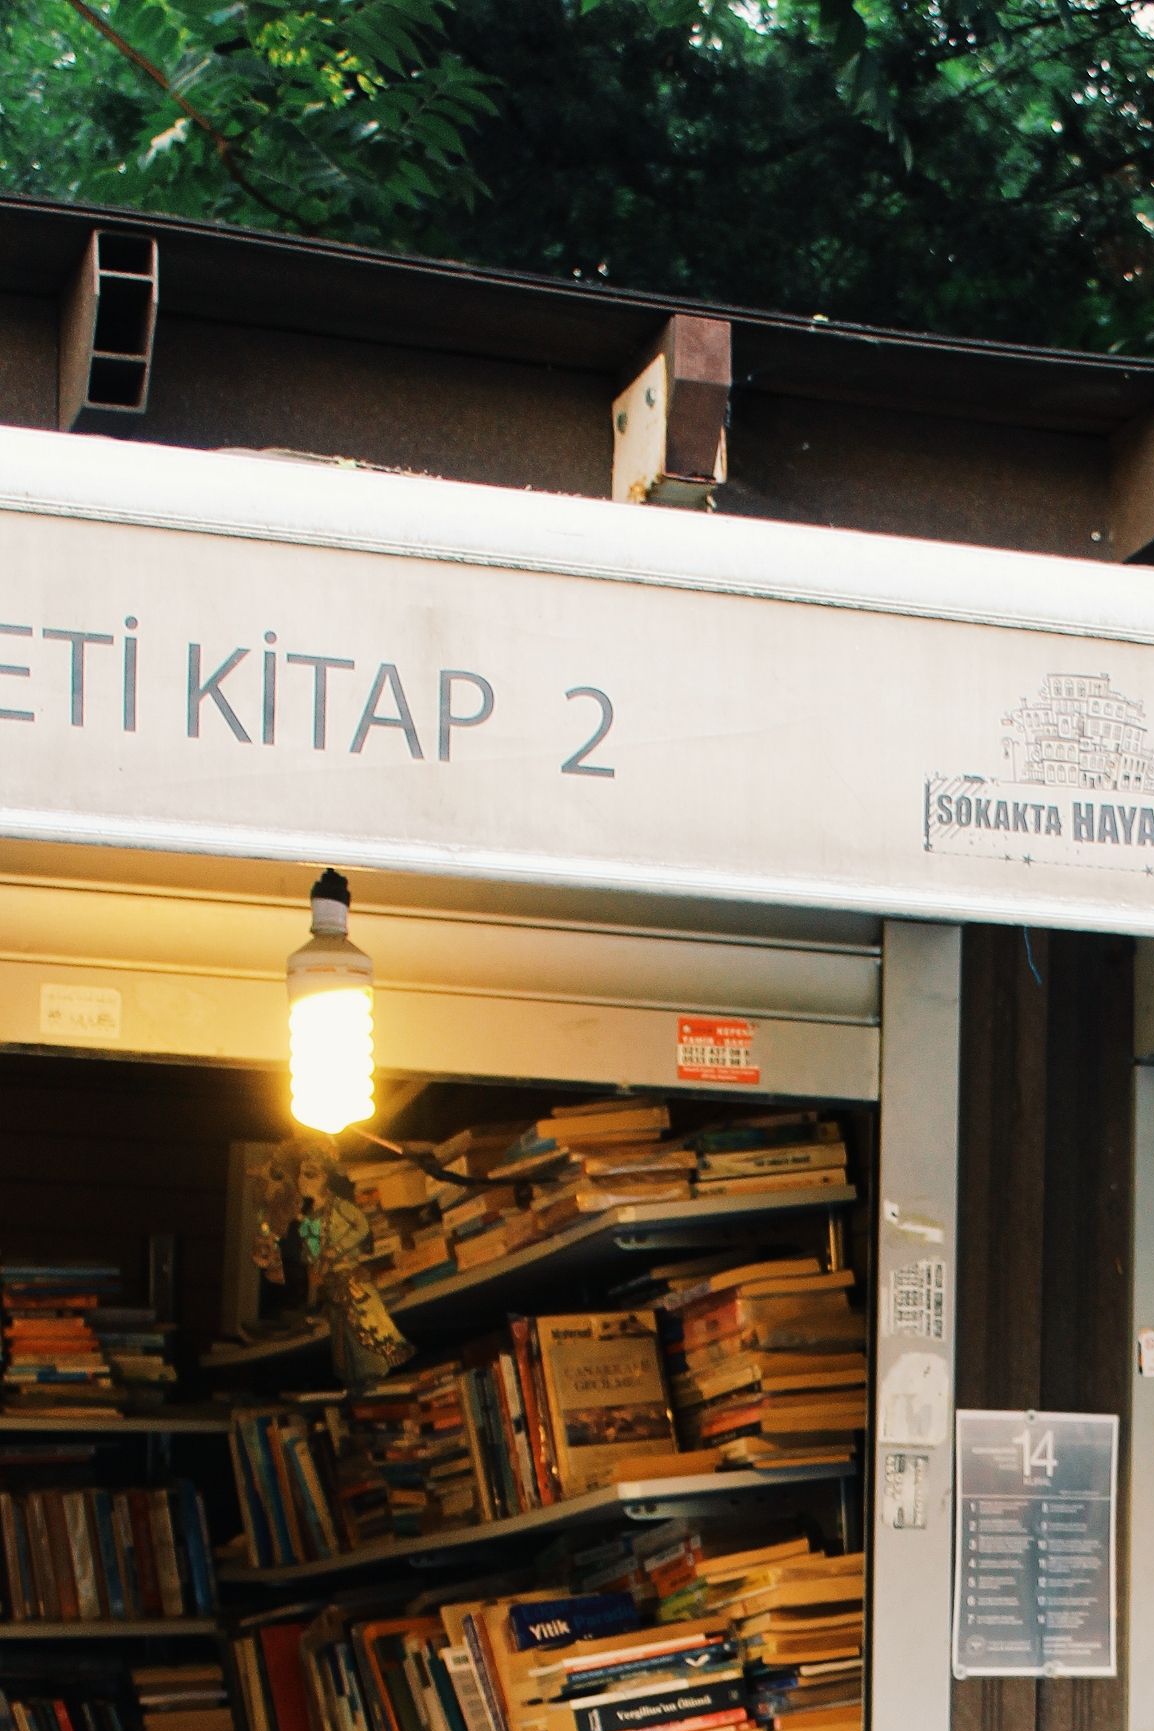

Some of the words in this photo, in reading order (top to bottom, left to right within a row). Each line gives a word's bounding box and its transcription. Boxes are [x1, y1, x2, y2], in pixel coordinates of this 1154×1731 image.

[185, 630, 496, 763] KİTAP
[560, 685, 616, 779] 2
[936, 794, 1062, 838] SOKAKTA
[1011, 1428, 1059, 1478] 14
[528, 1618, 571, 1642] Yitik
